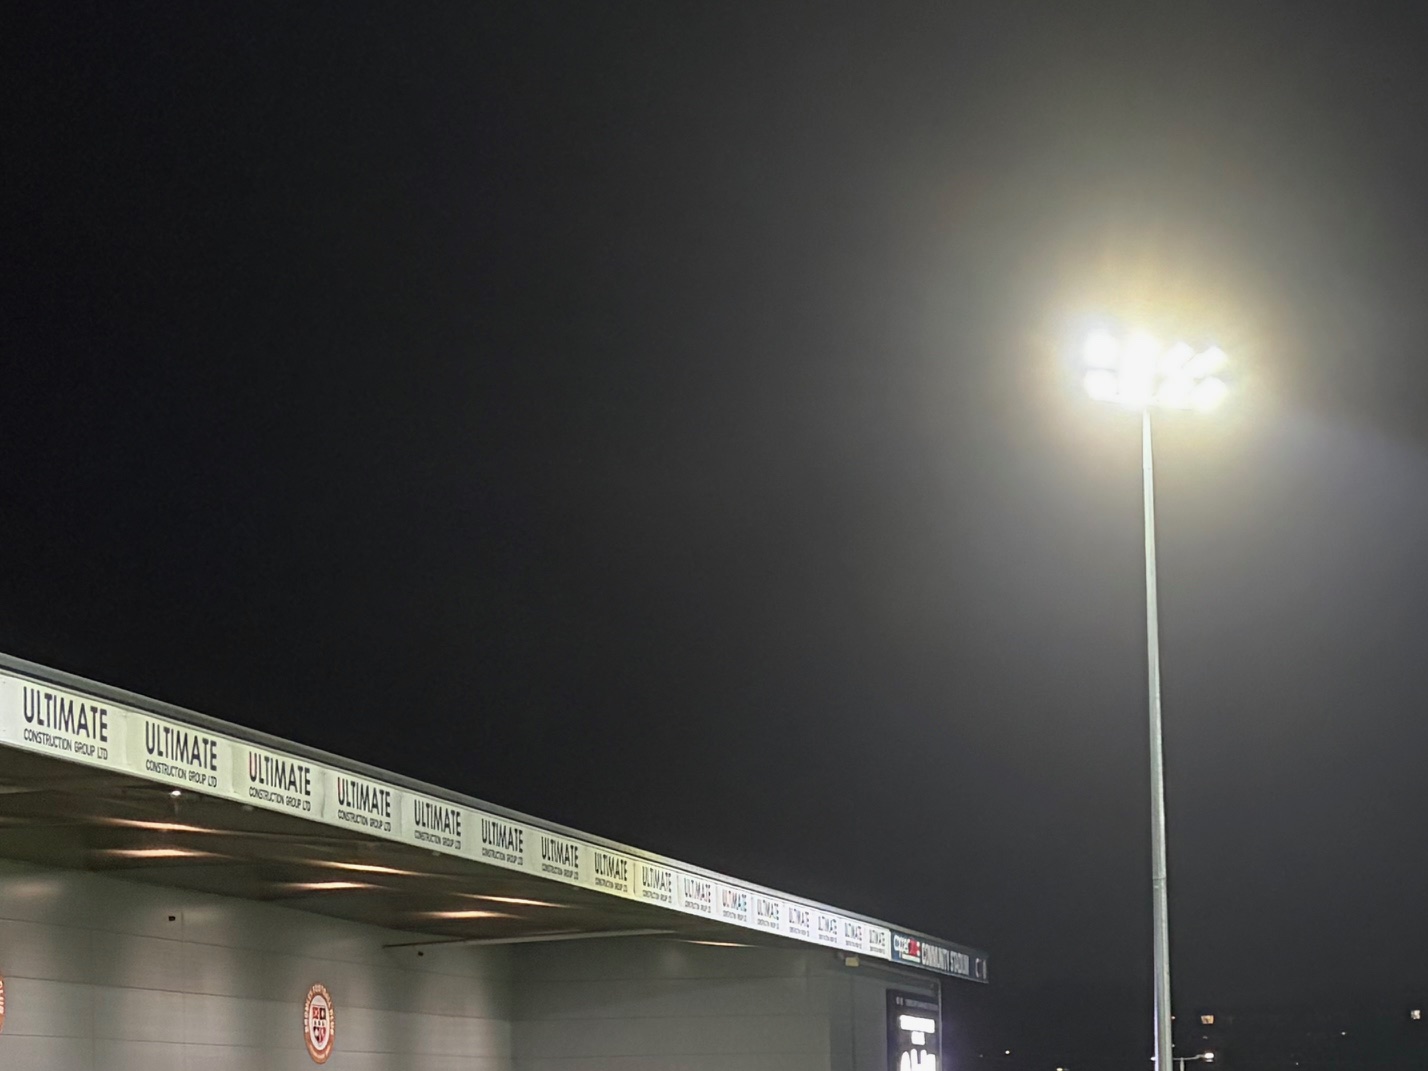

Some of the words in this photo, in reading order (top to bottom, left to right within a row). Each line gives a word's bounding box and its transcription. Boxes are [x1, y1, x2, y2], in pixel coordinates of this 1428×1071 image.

[24, 686, 108, 743] ULTIMATE
[23, 728, 72, 752] CONSTRUCTION
[74, 741, 96, 757] GROUP
[97, 747, 109, 761] LTD
[146, 721, 218, 772] ULTIMATE
[145, 759, 187, 781] CONSTRUCTION
[188, 770, 207, 784] GROUP
[208, 776, 218, 789] LTD
[249, 751, 311, 796] ULTIMATE
[337, 776, 391, 818] ULTIMATE
[414, 799, 461, 837] ULTIMATE
[481, 818, 523, 853] ULTIMATE
[541, 836, 579, 868] ULTIMATE
[594, 852, 628, 881] ULTIMATE
